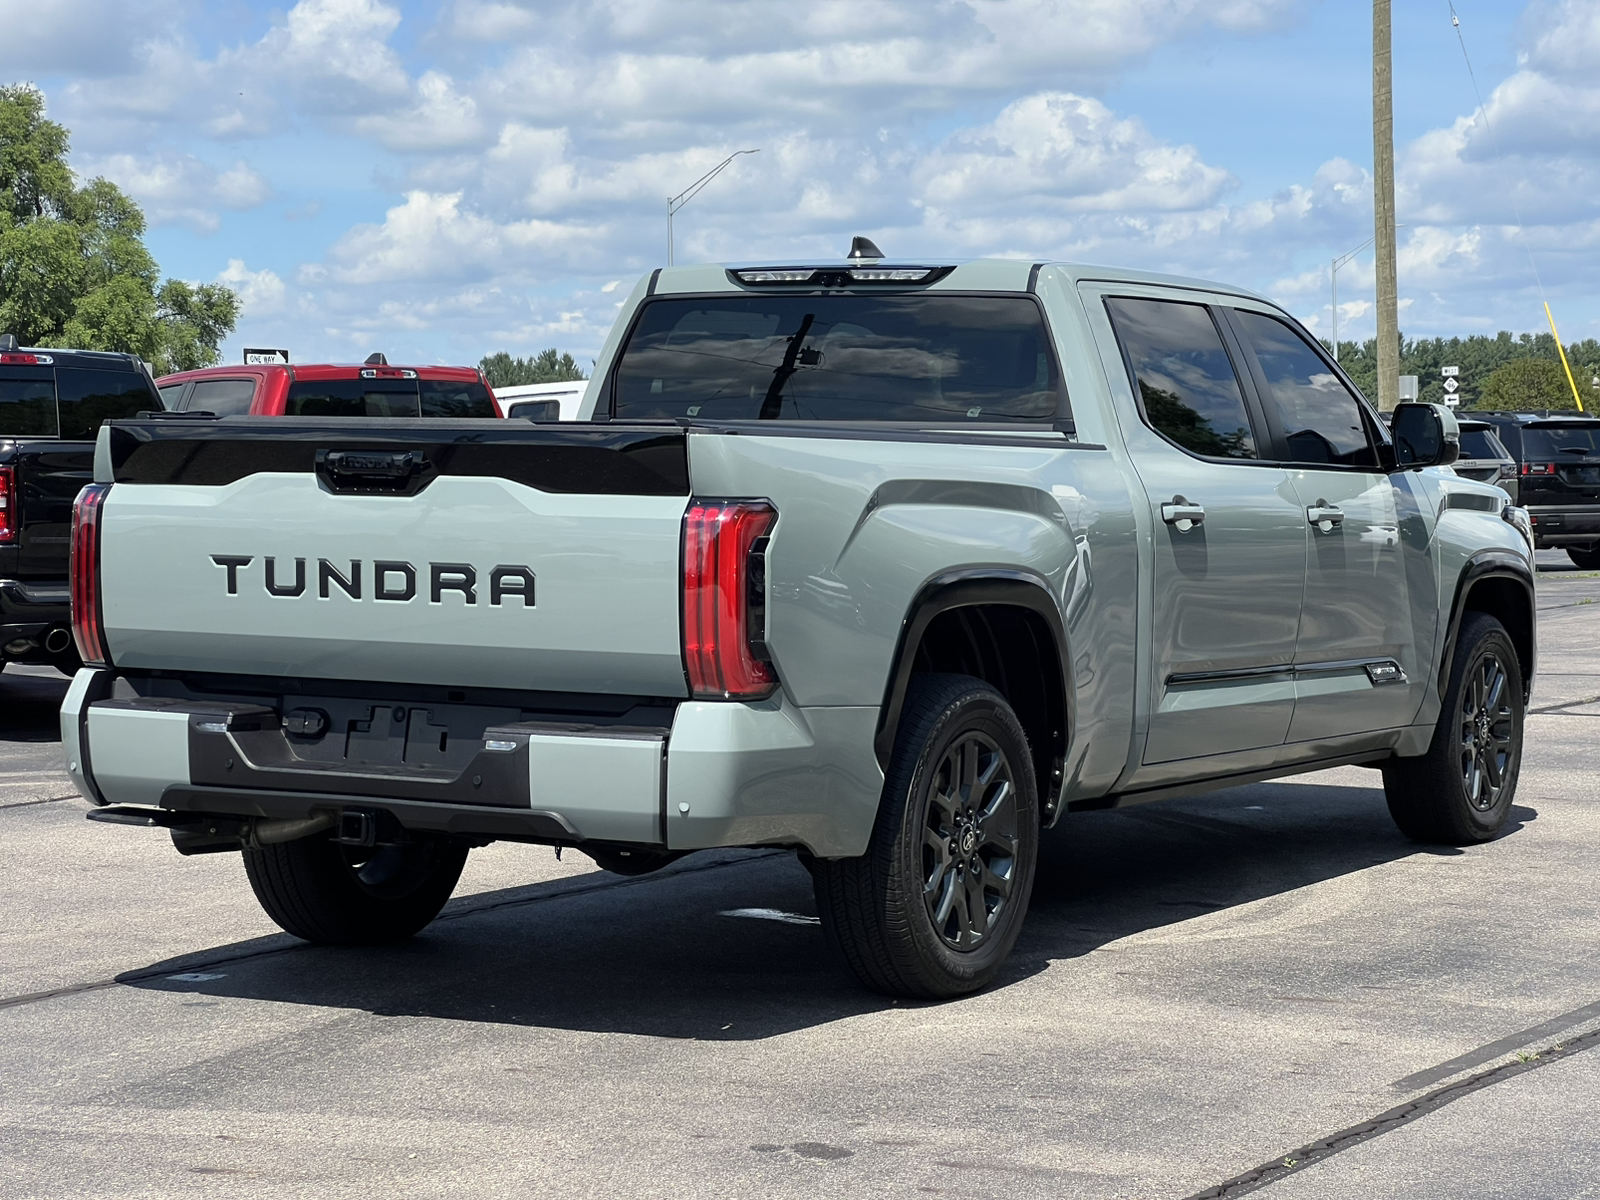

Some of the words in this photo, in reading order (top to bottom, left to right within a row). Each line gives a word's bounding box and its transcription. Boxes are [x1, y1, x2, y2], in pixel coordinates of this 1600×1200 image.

[250, 355, 261, 363] ONE
[264, 356, 275, 364] WAY
[347, 456, 389, 468] TOYOTA
[208, 554, 537, 610] TUNDRA
